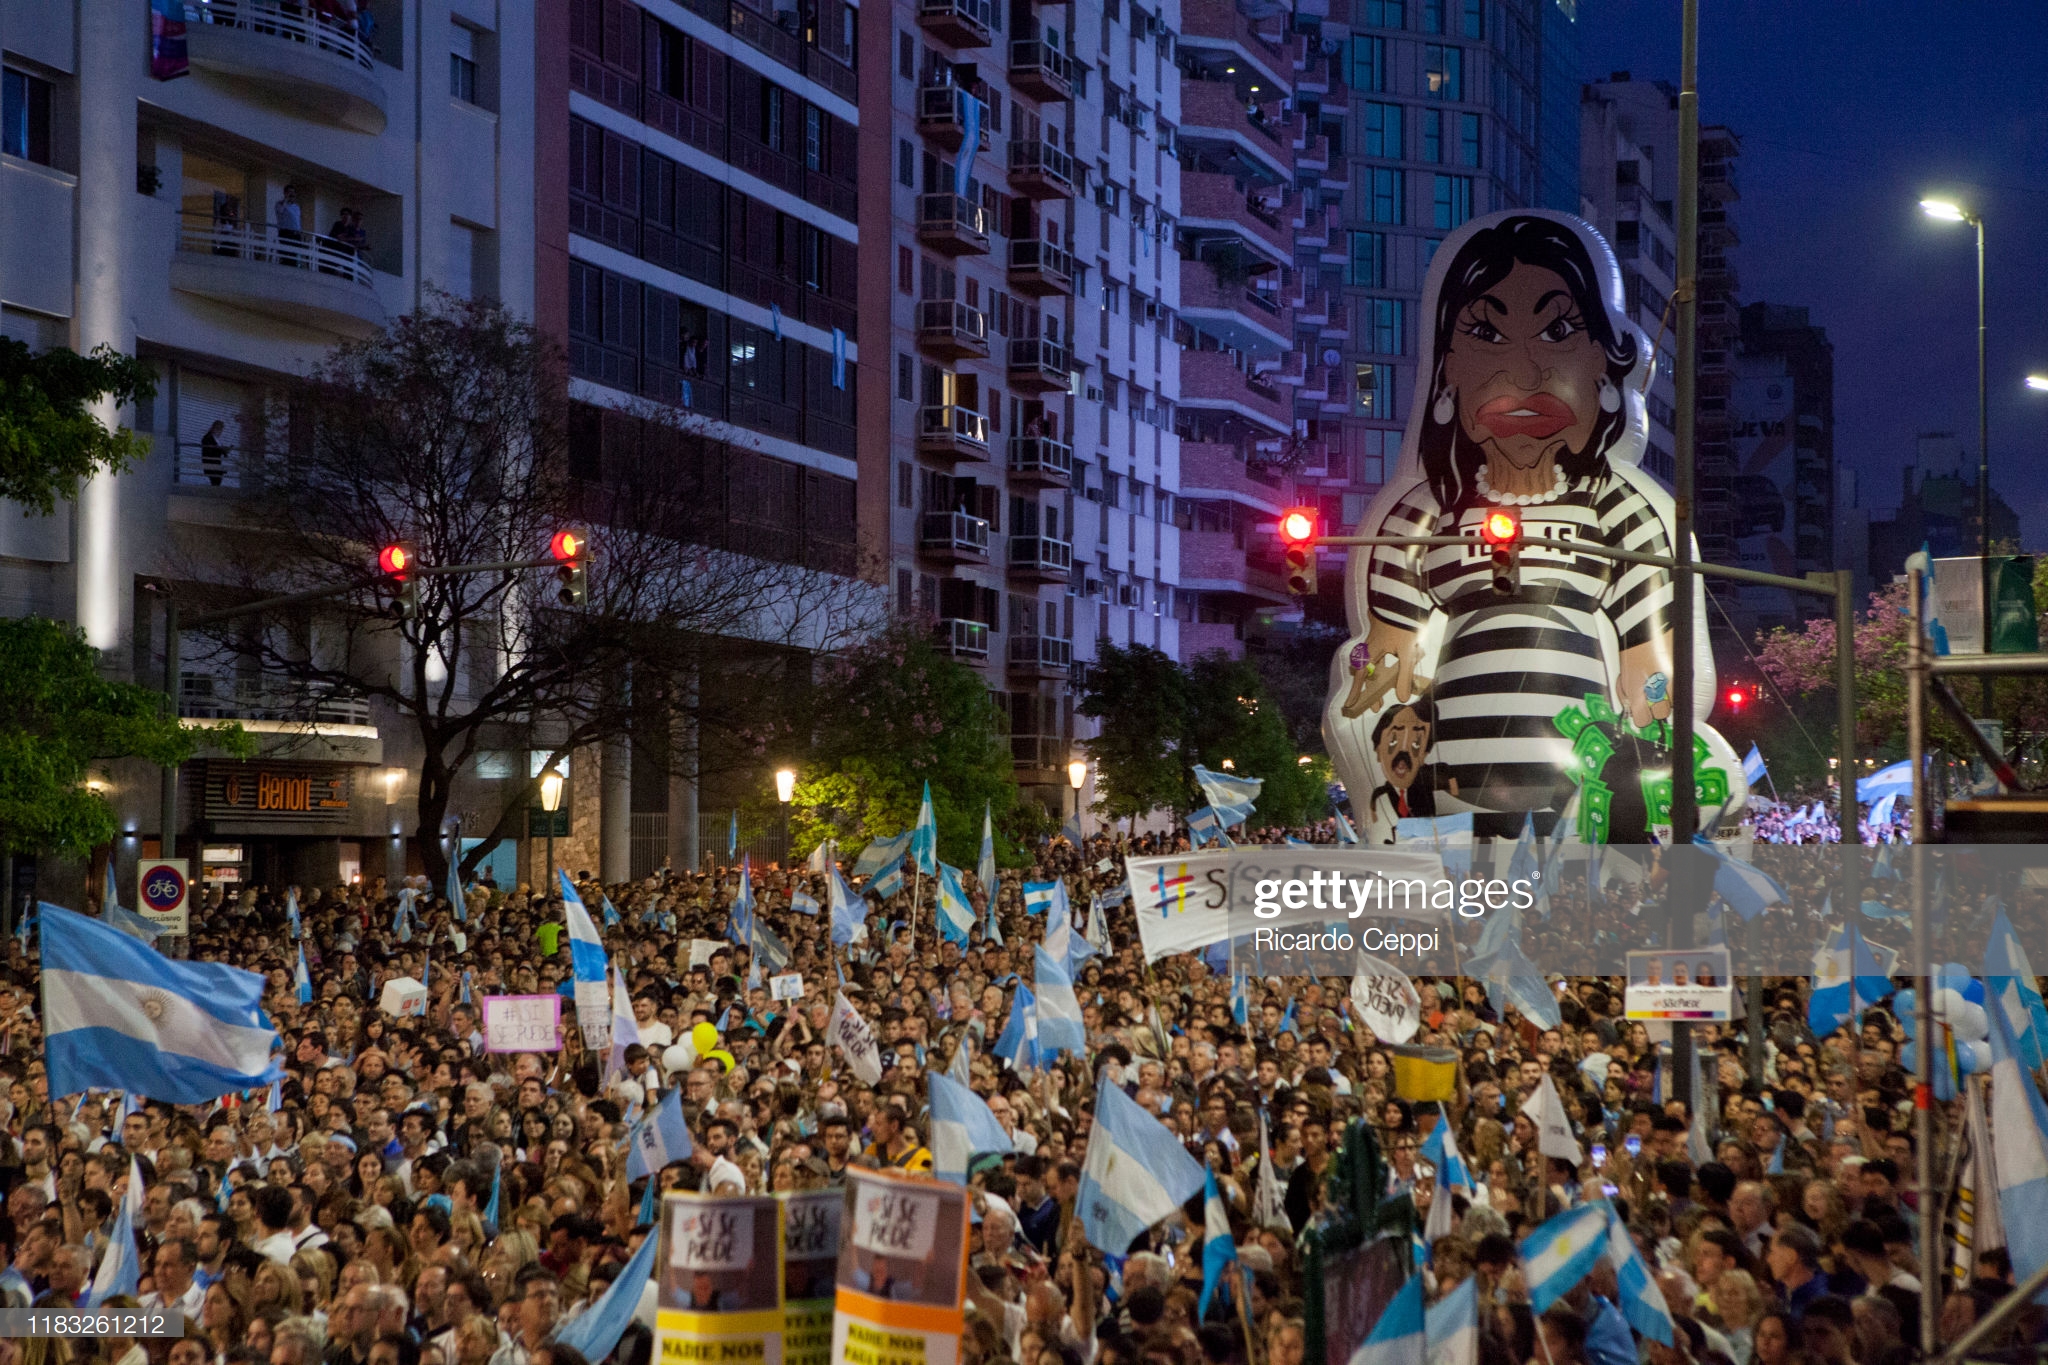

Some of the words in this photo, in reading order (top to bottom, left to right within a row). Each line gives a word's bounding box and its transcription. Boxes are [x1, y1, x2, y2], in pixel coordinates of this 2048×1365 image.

[258, 772, 312, 811] Benoit
[662, 1338, 713, 1361] NADIE
[721, 1341, 765, 1360] NOS
